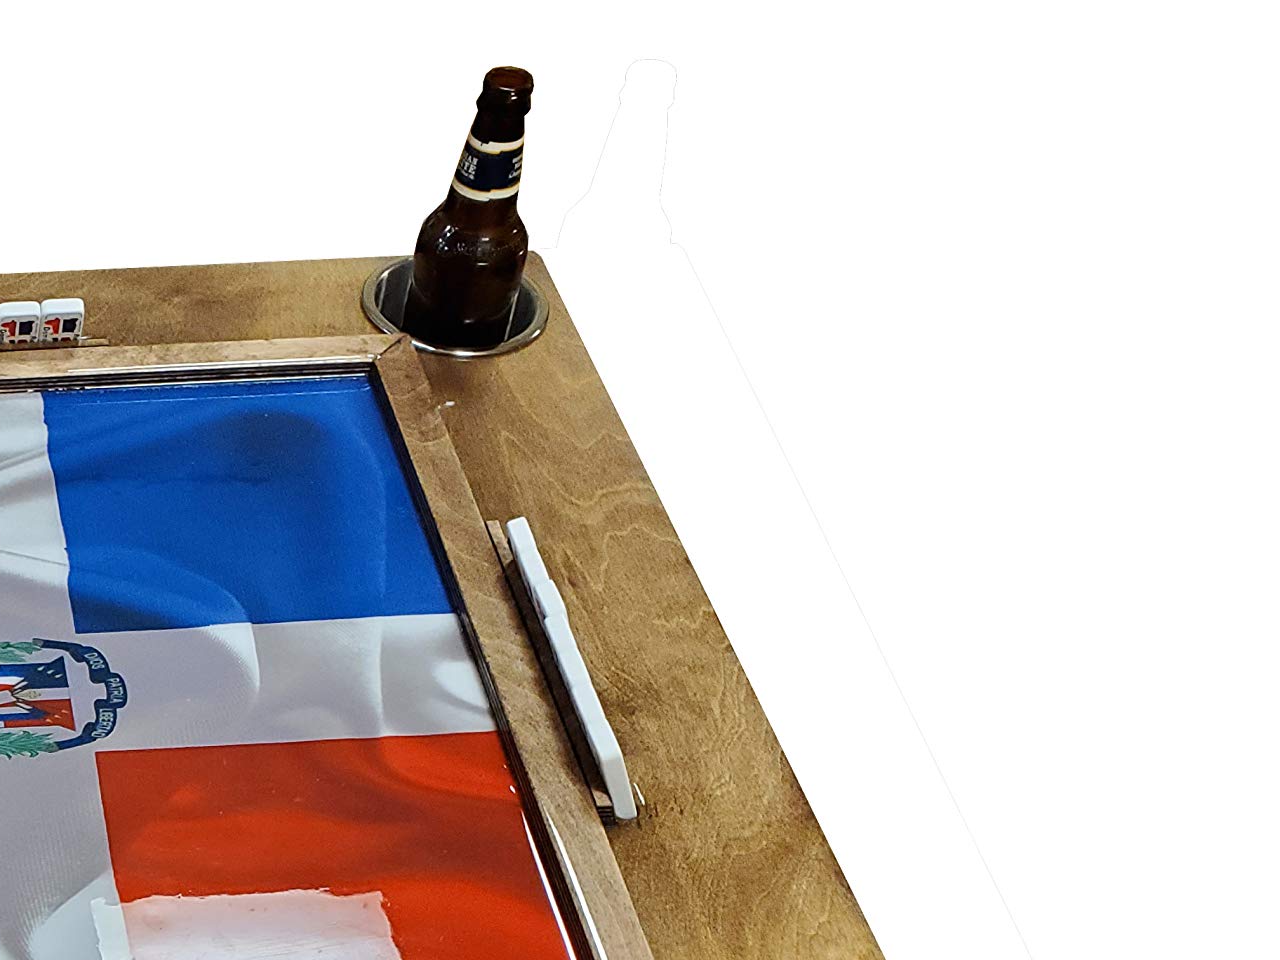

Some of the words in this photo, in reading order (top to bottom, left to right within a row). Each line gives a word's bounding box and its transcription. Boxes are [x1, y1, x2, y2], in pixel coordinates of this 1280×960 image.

[84, 652, 105, 669] DIOS
[106, 677, 124, 704] PATRIA
[91, 708, 113, 738] LIBERTAD
